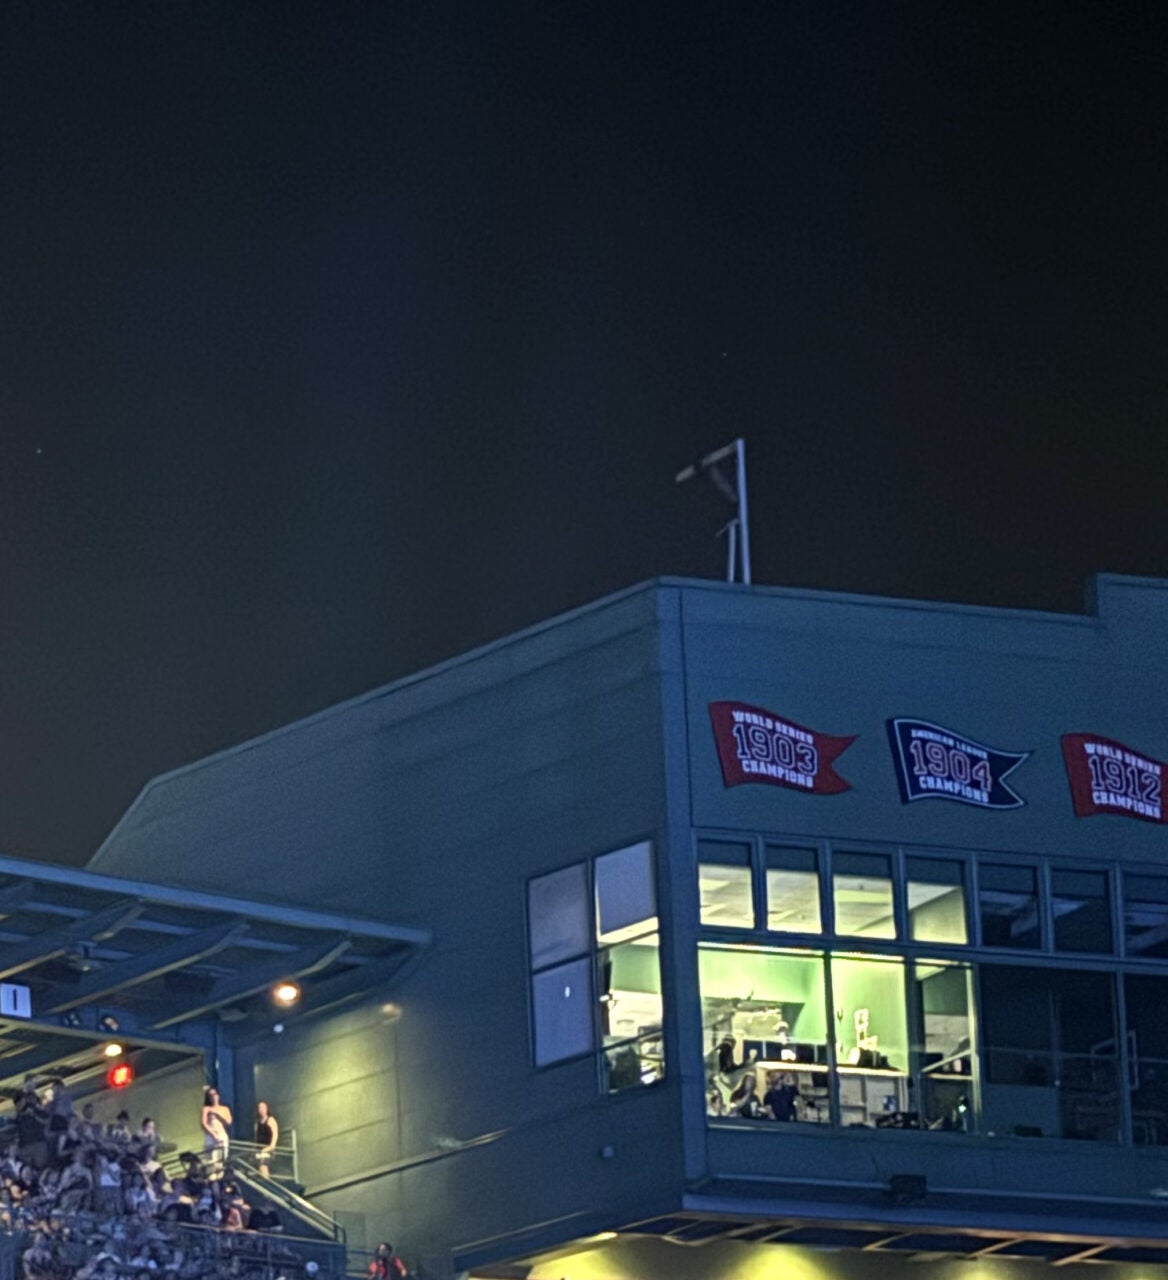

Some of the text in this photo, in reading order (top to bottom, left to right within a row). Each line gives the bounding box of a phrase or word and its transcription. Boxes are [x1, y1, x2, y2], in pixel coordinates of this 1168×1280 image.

[731, 710, 814, 745] WORLD SERIES
[733, 723, 818, 776] 1903
[1084, 742, 1161, 775] WORLD SERIES
[741, 759, 814, 788] CHAMPIONS
[910, 740, 992, 793] 1904
[1088, 755, 1161, 806] 1912
[919, 776, 989, 803] CHAMPIONS
[1092, 790, 1161, 819] CHAMPIONS
[12, 988, 19, 1011] 1
